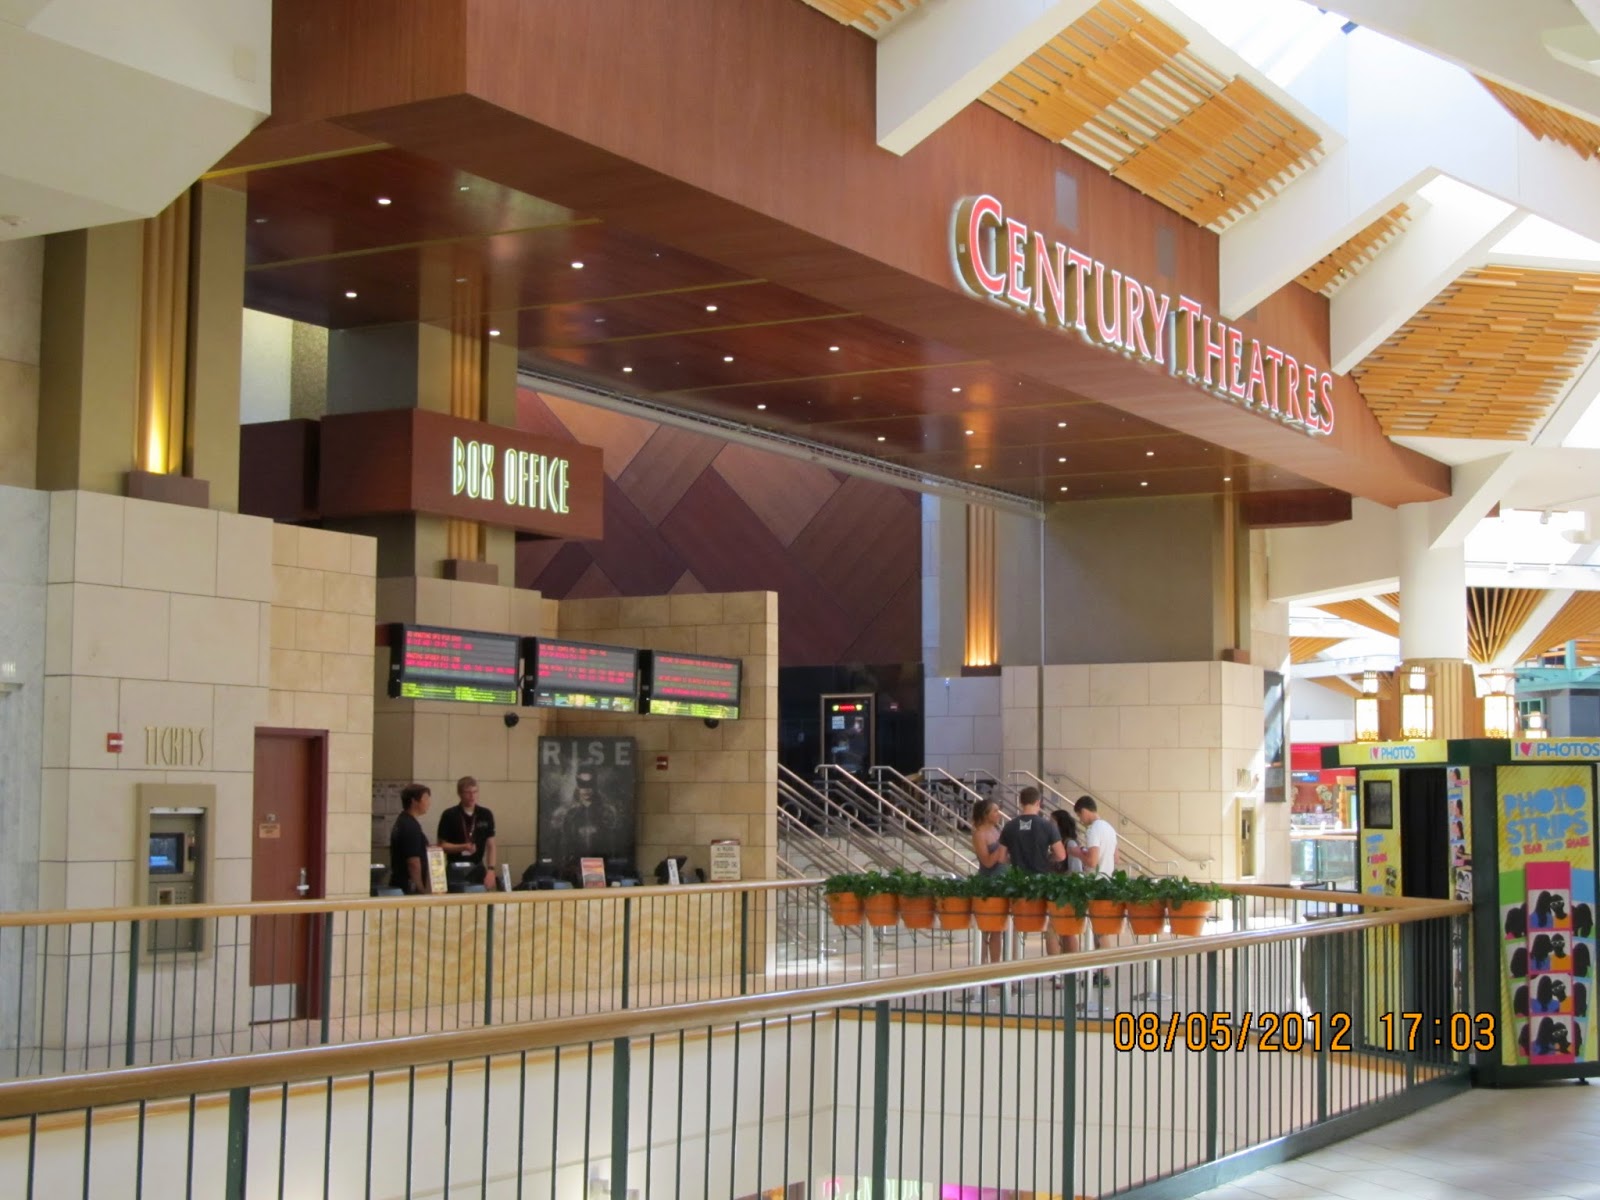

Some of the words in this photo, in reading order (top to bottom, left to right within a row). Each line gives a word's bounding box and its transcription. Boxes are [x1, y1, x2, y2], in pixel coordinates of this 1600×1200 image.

[966, 193, 1170, 365] CENTURY
[1178, 294, 1334, 436] THEATRES
[452, 435, 495, 501] BOX
[504, 447, 570, 514] OFFICE
[542, 740, 633, 766] RISE
[1381, 745, 1416, 760] PHOTOS
[1515, 743, 1519, 756] I
[1536, 742, 1600, 757] PHOTOS
[1503, 784, 1586, 818] PHOTO
[1506, 810, 1589, 845] STRIPS
